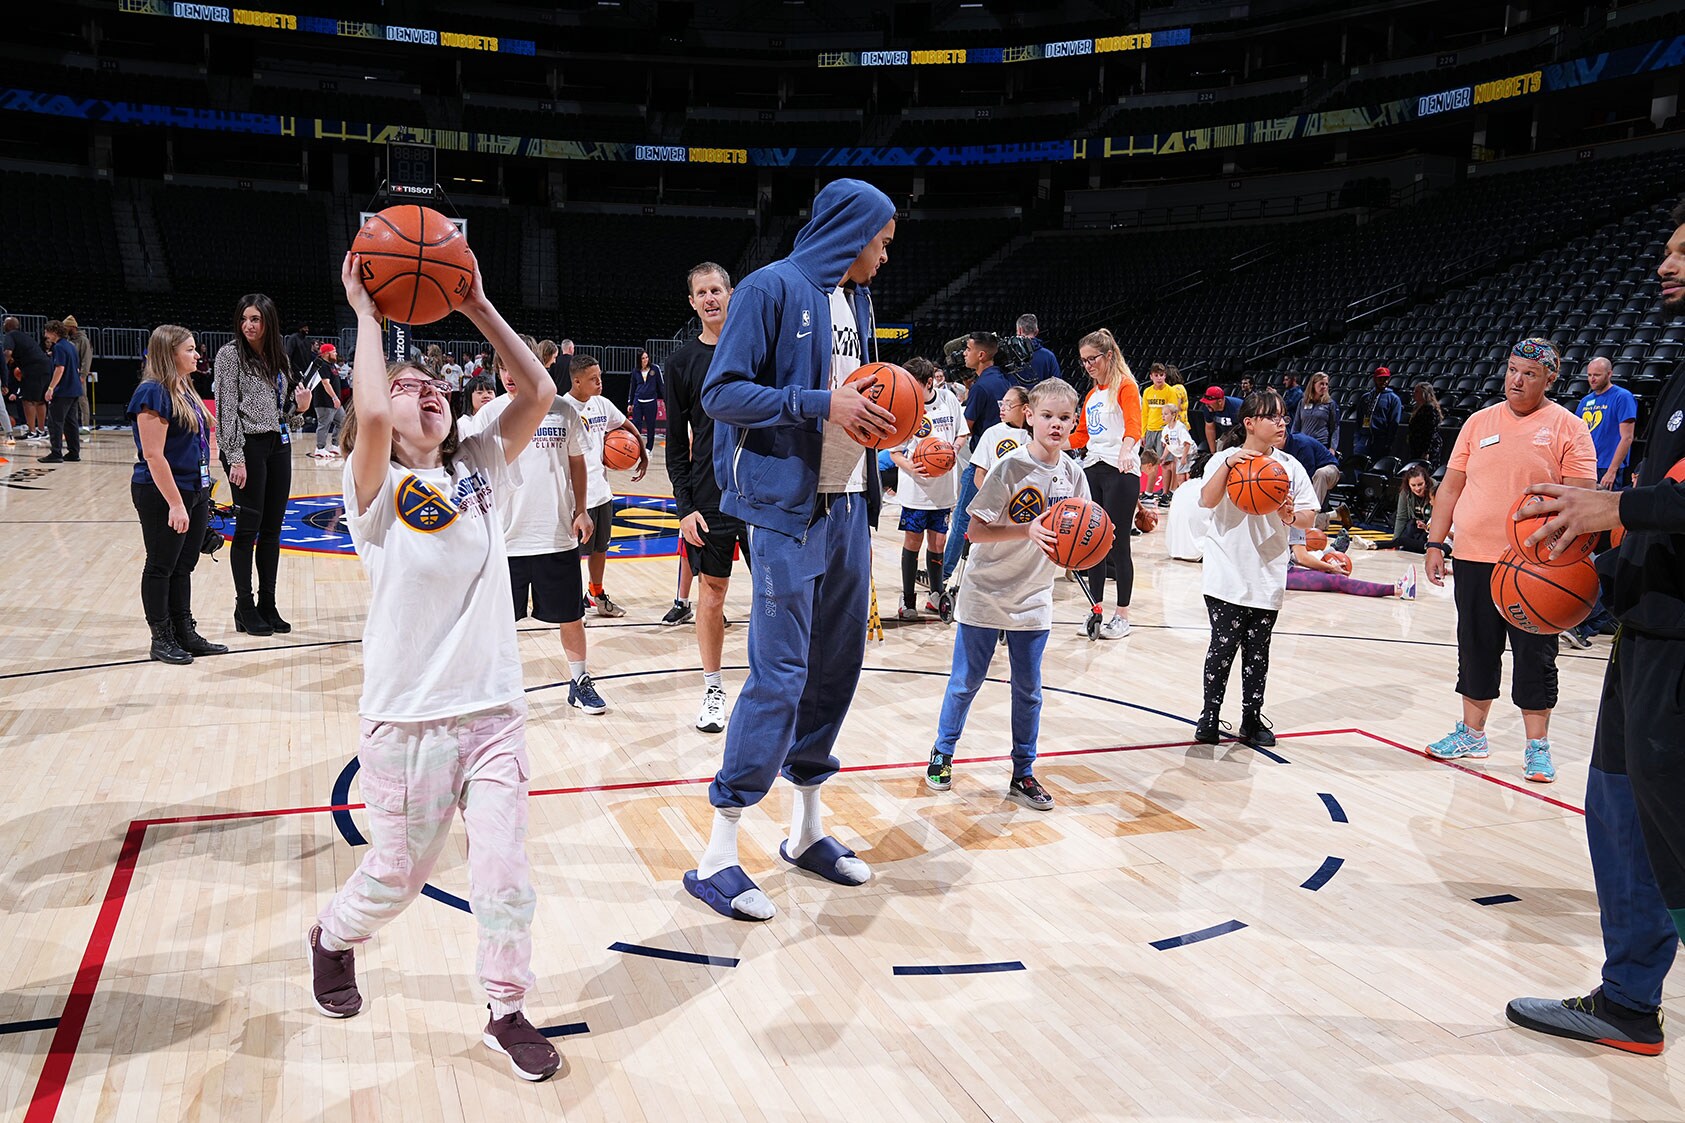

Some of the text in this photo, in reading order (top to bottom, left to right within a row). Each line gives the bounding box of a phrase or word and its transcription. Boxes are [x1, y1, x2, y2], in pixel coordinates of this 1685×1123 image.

[173, 2, 297, 30] DENVER NUGGETS
[386, 25, 499, 52] DENVER NUGGETS
[1045, 32, 1152, 59] DENVER NUGGETS
[861, 49, 967, 66] DENVER NUGGETS
[1439, 55, 1454, 66] 226
[1200, 93, 1213, 101] 224
[1418, 71, 1543, 117] DENVER NUGGETS
[635, 145, 747, 164] DENVER NUGGETS
[396, 330, 405, 362] erizon
